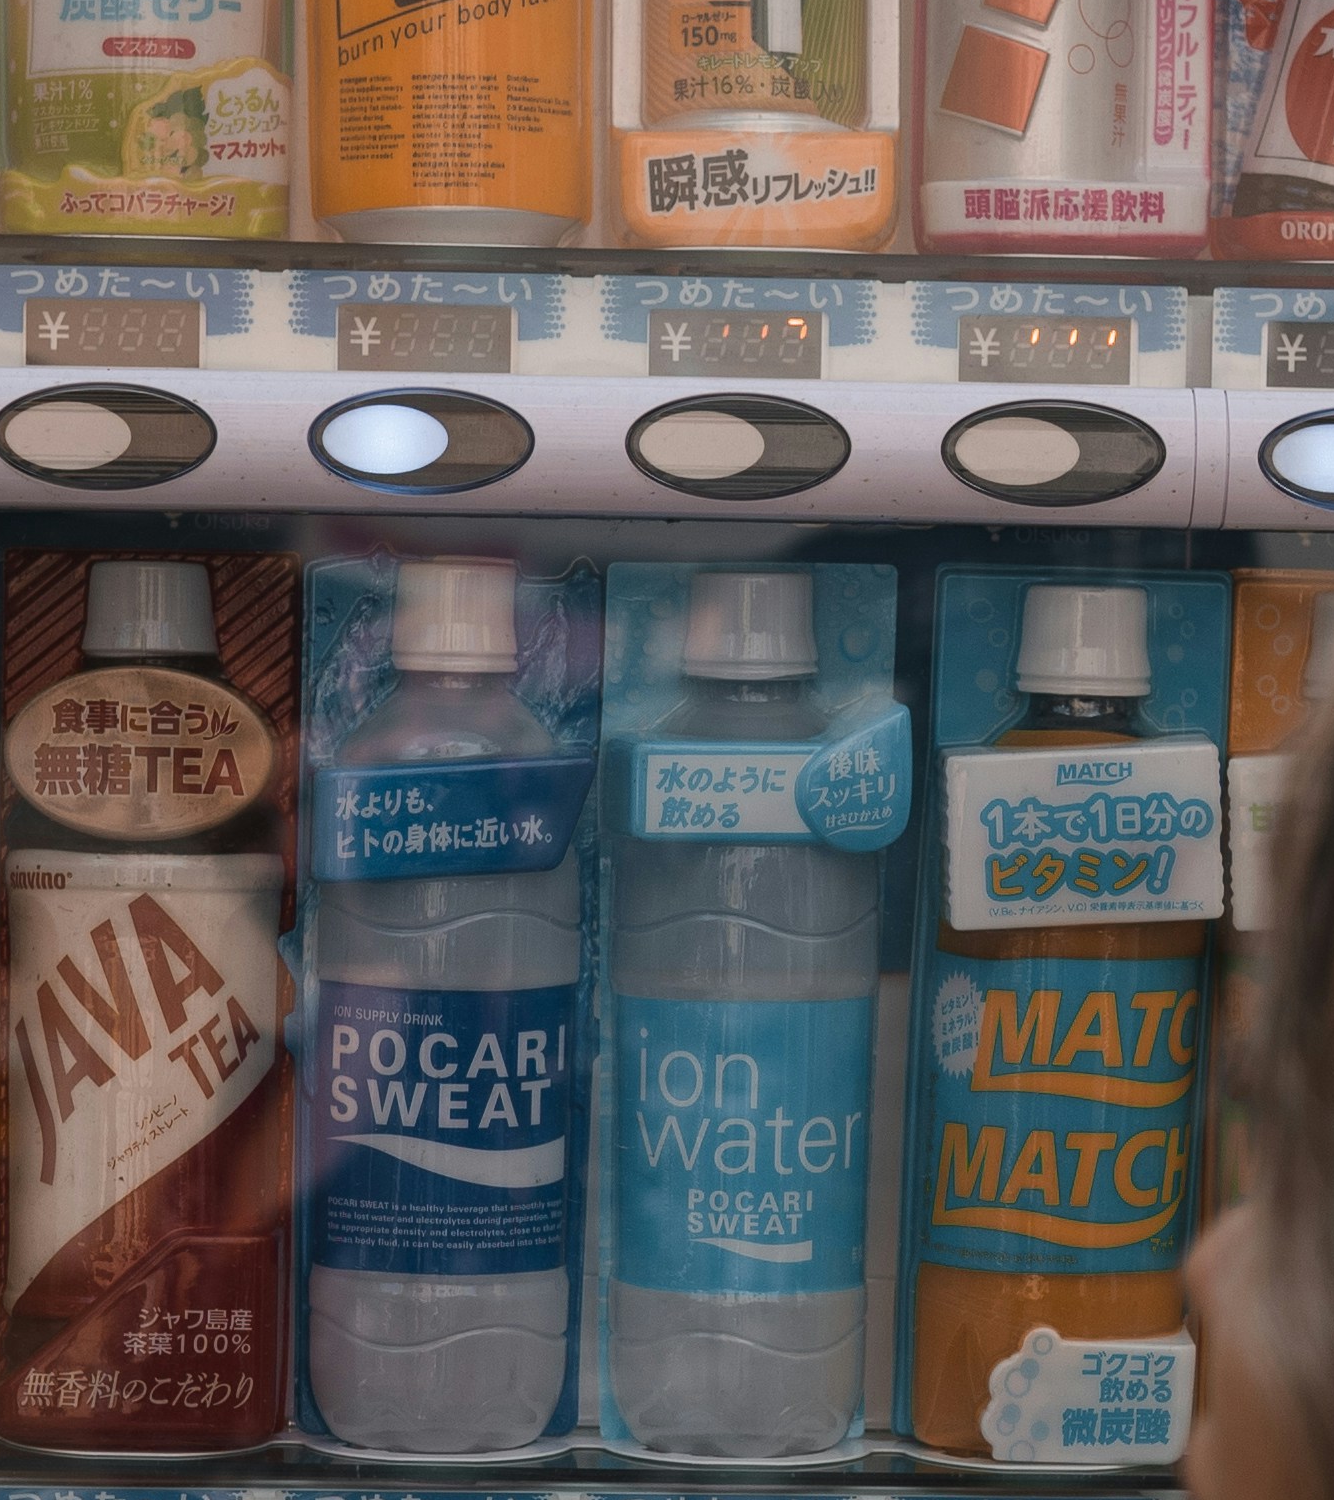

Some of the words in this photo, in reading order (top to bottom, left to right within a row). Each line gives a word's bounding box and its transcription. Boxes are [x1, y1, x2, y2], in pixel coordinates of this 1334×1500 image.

[338, 34, 383, 67] burn
[391, 9, 447, 48] your
[964, 189, 1165, 223] 頭脳派応援飲料
[53, 699, 207, 736] 食事に合う
[34, 744, 243, 796] 無糖TEA
[656, 762, 786, 795] 水のように
[1057, 762, 1132, 787] MATCH
[335, 788, 433, 820] 水よりも、
[659, 797, 740, 828] 飲める
[988, 799, 1207, 843] 1本で1日分の
[336, 815, 552, 858] ヒトの身体に近い水。
[334, 1006, 351, 1017] ION
[356, 1008, 399, 1024] SUPPLY
[403, 1013, 442, 1026] DRINK
[16, 892, 225, 1186] JAVA
[170, 994, 258, 1099] TEA
[332, 1024, 565, 1079] POCARI
[638, 1028, 759, 1109] ion
[330, 1075, 551, 1128] SWEAT
[639, 1109, 861, 1175] water
[932, 1123, 1190, 1227] MATCH
[688, 1188, 814, 1212] POCARI
[688, 1213, 803, 1235] SWEAT
[139, 1309, 254, 1331] ジャワ島産
[1082, 1342, 1175, 1368] ゴクゴク
[21, 1368, 255, 1411] 無香料のこだわり
[1099, 1378, 1172, 1403] 飲める
